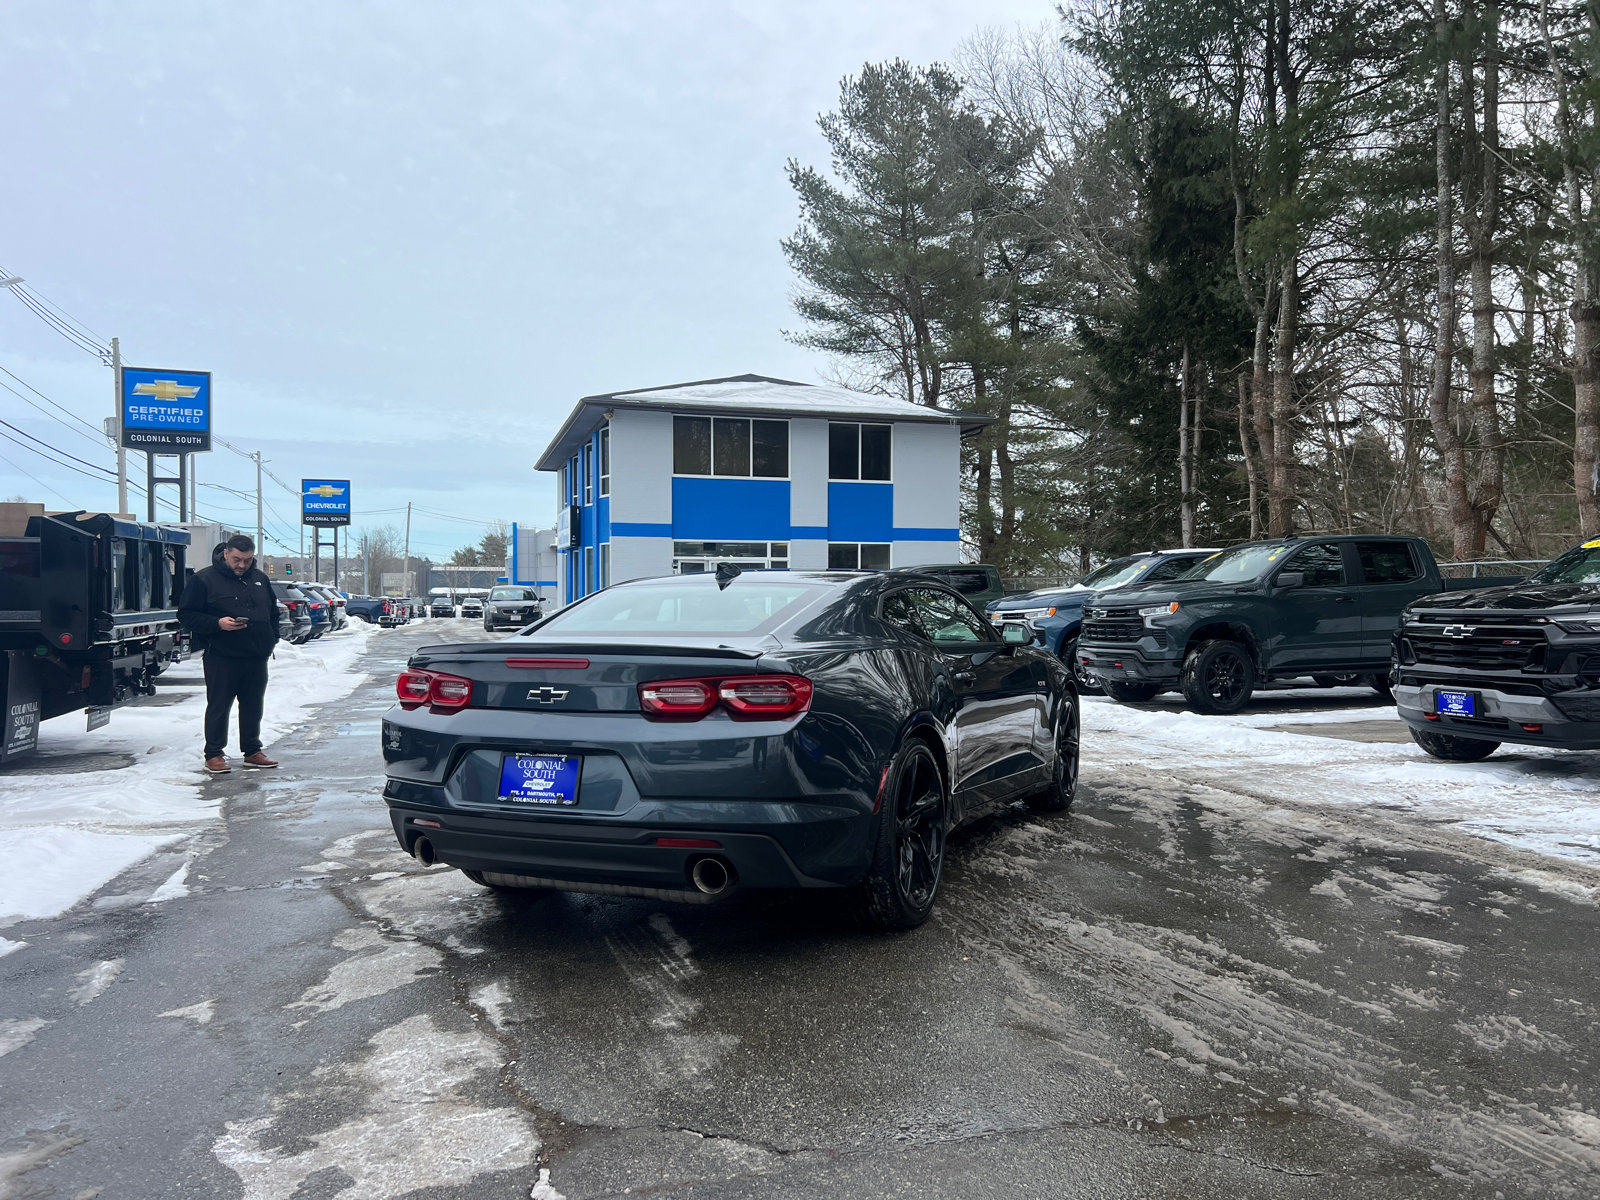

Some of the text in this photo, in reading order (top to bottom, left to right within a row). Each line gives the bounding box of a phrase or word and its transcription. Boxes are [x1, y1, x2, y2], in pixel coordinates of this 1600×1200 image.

[128, 405, 204, 417] CERTIFIED
[132, 413, 200, 424] PRE-OWNED
[130, 434, 202, 444] COLONIAL SOUTH
[306, 502, 347, 510] CHEVROLET
[11, 701, 39, 716] COLONIAL
[14, 713, 35, 727] SOUTH
[517, 759, 564, 770] COLONIAL
[522, 769, 556, 779] SOUTH
